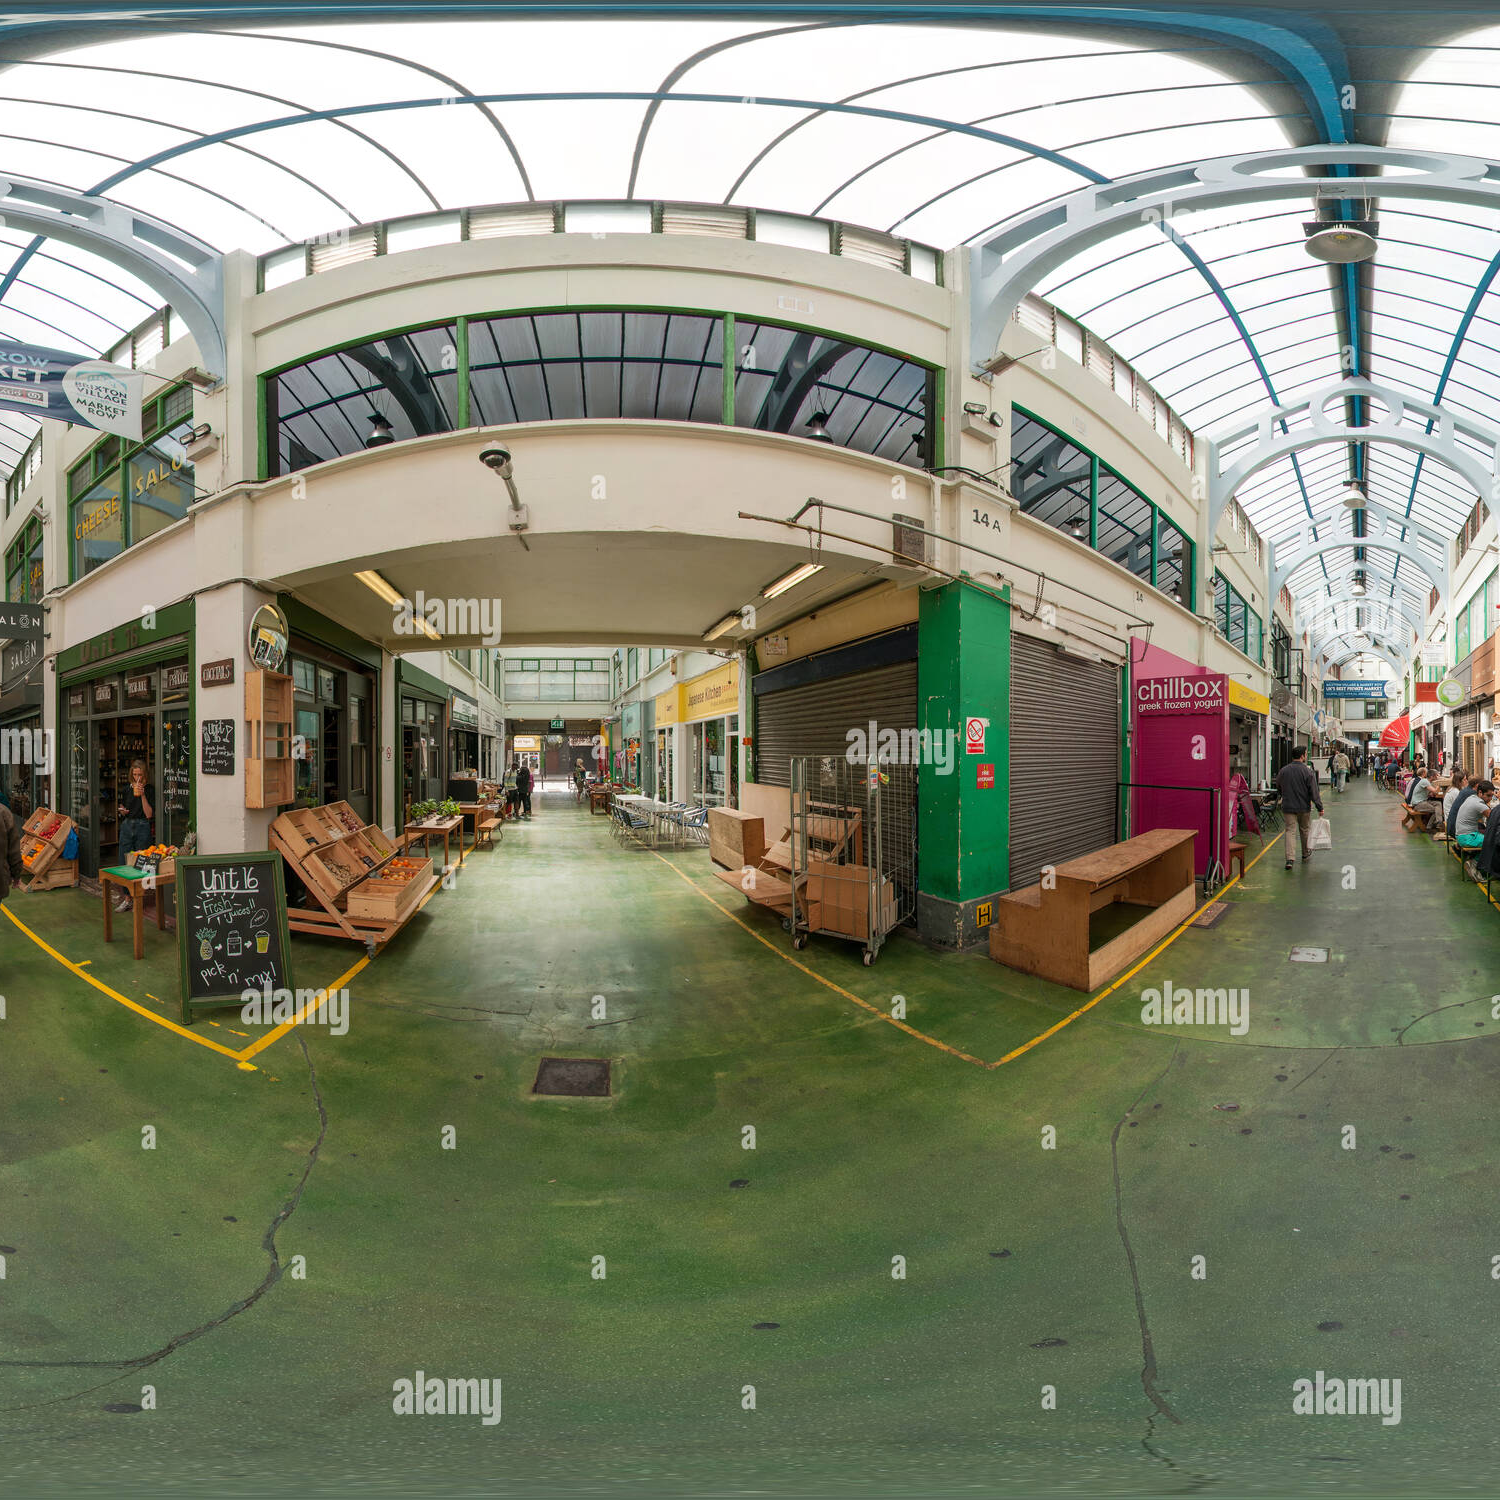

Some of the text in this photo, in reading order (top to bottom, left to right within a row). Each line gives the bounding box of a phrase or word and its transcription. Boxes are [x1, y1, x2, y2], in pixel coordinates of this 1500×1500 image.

[75, 381, 128, 399] BRIXTON
[76, 387, 128, 406] VILLAGE
[75, 398, 128, 417] MARKET
[87, 407, 117, 420] ROW
[75, 494, 119, 541] CHEESE
[972, 508, 990, 528] 14
[80, 625, 139, 663] Unit 16
[202, 664, 231, 682] COCKTAILS
[1137, 677, 1222, 701] chillbox
[1138, 698, 1223, 713] greek frozen yogurt
[200, 867, 259, 892] Unit 16
[203, 896, 232, 915] Fresh
[200, 960, 227, 986] pick
